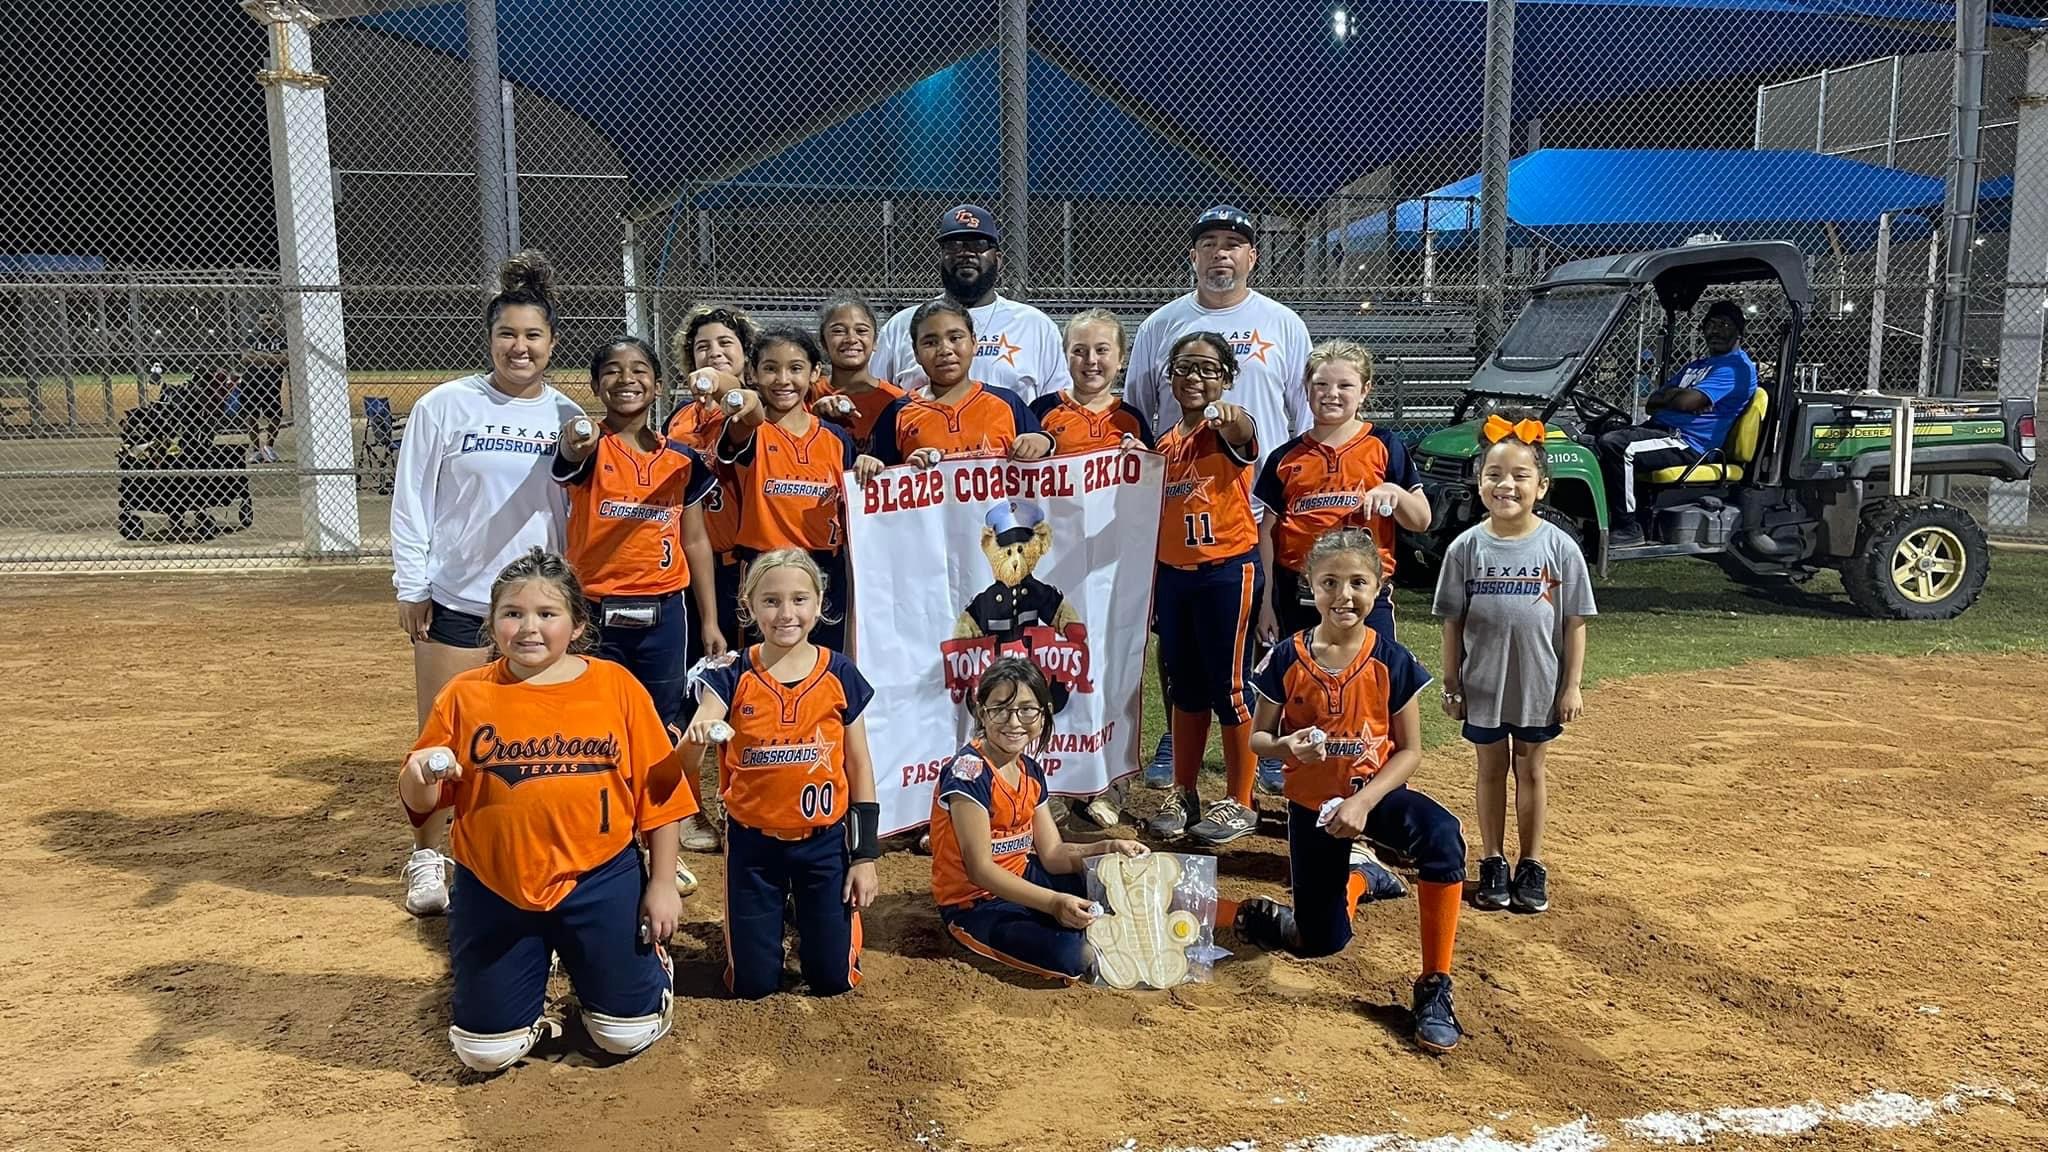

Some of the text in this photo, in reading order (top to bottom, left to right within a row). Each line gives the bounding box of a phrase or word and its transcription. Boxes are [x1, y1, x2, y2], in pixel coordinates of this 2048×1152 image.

[485, 425, 558, 440] TEXAS
[1827, 428, 1885, 438] JOHN DEERE
[1976, 426, 2001, 435] GATOR
[461, 433, 557, 456] CROSSROAD
[1547, 453, 1578, 463] 21103
[764, 480, 828, 497] CROSSROADS
[600, 501, 670, 521] CROSSROADS
[1184, 512, 1216, 547] 11
[660, 538, 672, 568] 3
[947, 646, 1082, 680] TOYS TOTS
[742, 747, 818, 765] CROSSROADS
[519, 764, 579, 775] TEXAS
[801, 782, 834, 819] 00
[599, 788, 611, 834] 1
